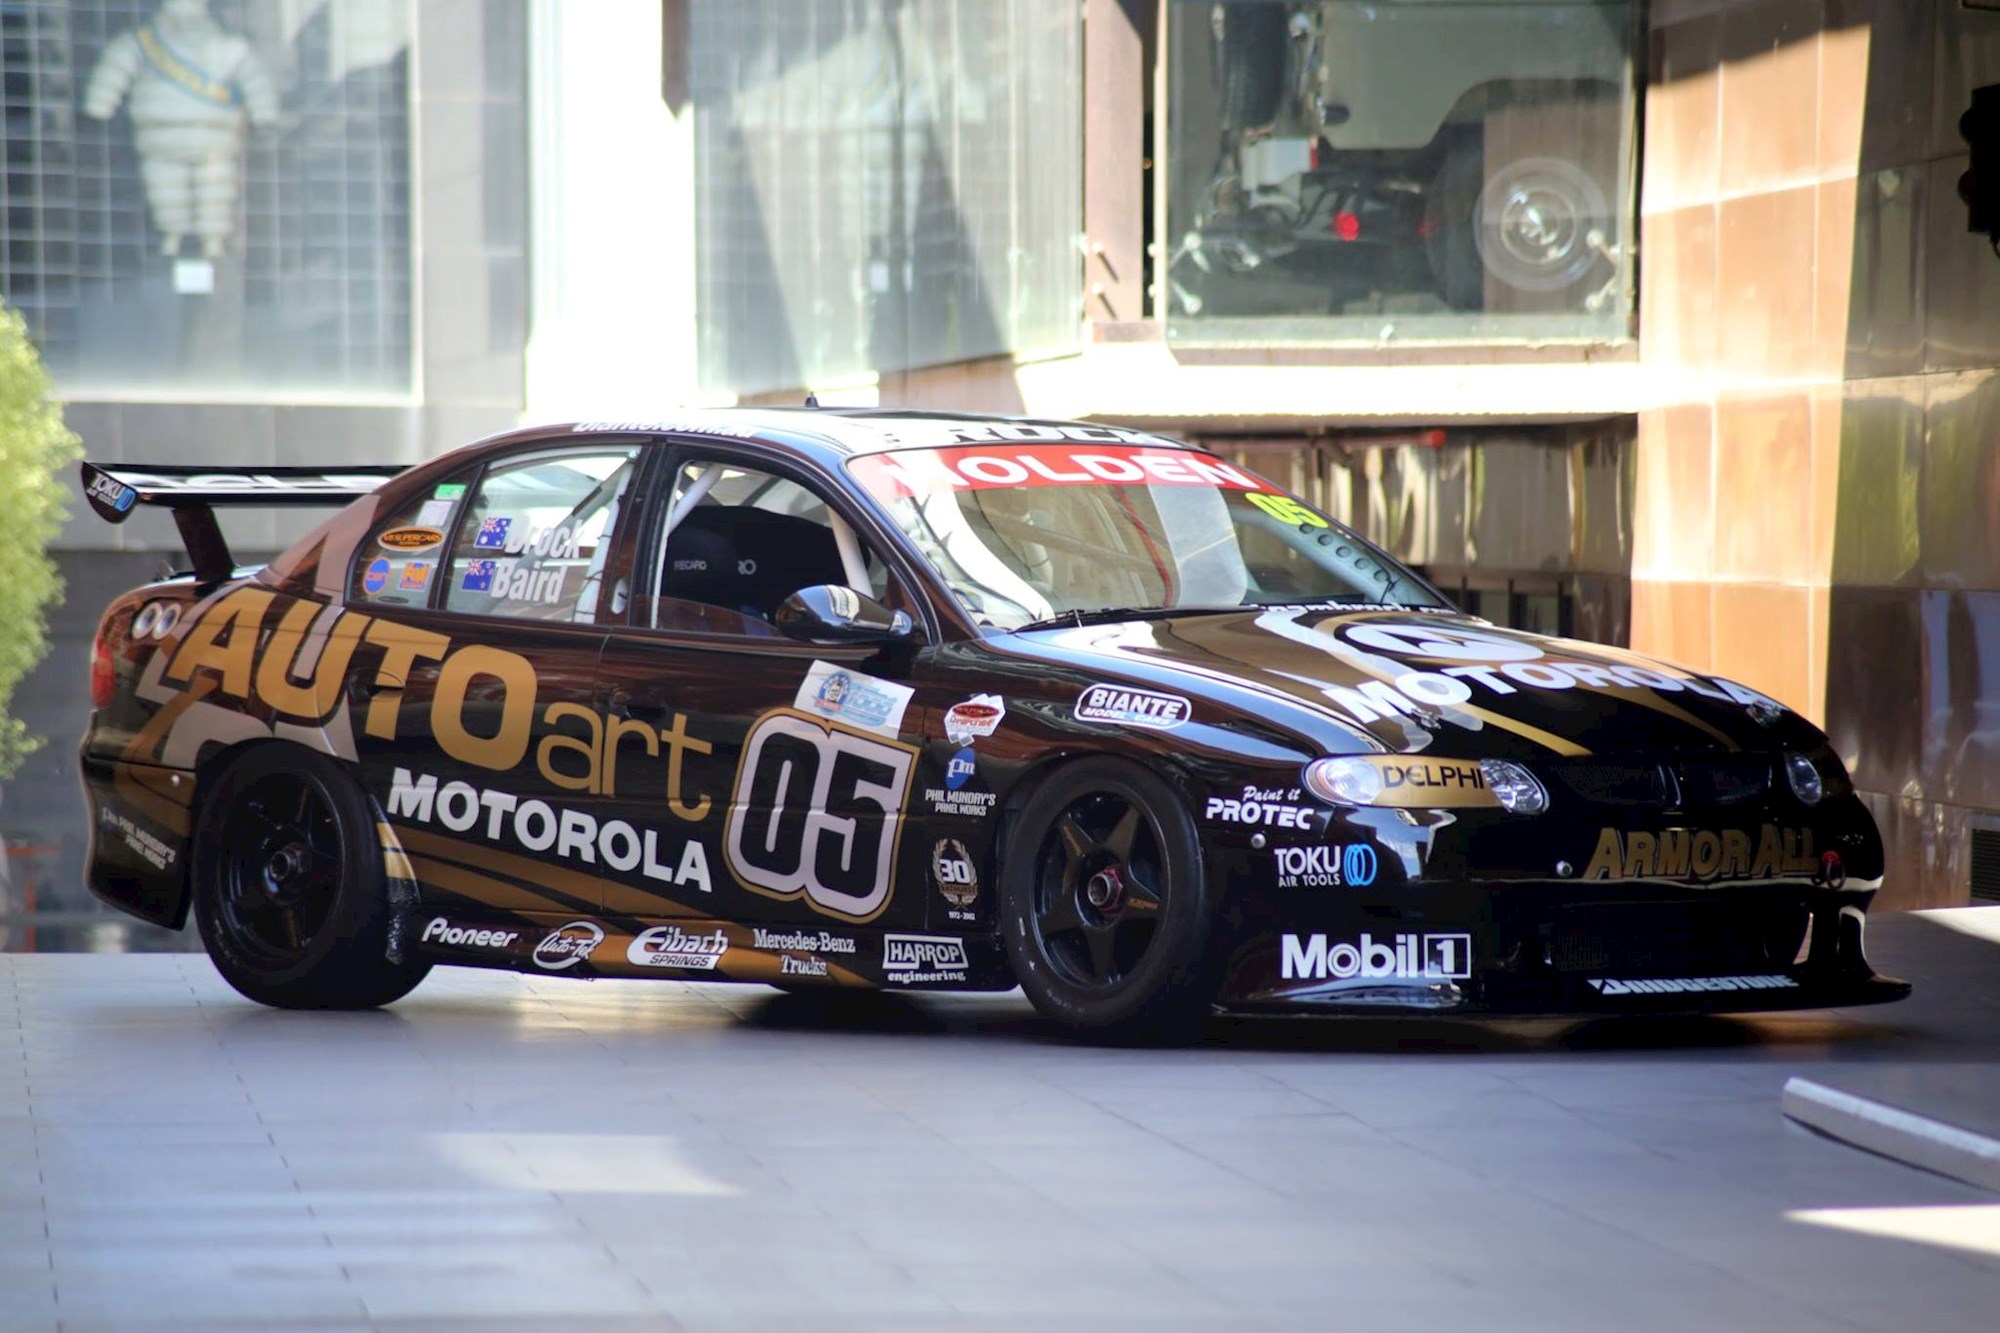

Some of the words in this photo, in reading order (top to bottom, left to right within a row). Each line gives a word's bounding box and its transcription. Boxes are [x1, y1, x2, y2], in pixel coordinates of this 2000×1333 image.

[872, 425, 1178, 448] ROCK
[878, 453, 1260, 491] HOLDEN
[91, 472, 125, 499] TOKU
[1246, 492, 1329, 528] 05
[505, 514, 584, 558] Brock
[674, 560, 707, 571] RECARO
[491, 558, 569, 603] Baird
[1089, 688, 1183, 720] BIANTE
[1321, 662, 1791, 725] MOTOROLA
[1083, 708, 1127, 719] MODEL
[1383, 766, 1484, 789] DELPHI
[925, 789, 945, 802] PHIL
[947, 790, 996, 806] MUNDAY'S
[1243, 786, 1283, 802] Paint
[1289, 788, 1300, 801] it
[725, 709, 916, 921] 05
[935, 802, 958, 814] PANEL
[960, 805, 987, 816] WORKS
[1206, 798, 1314, 830] PROTEC
[387, 767, 712, 892] MOTOROLA
[1274, 846, 1341, 875] TOKU
[1583, 826, 1751, 880] ARMOR
[1749, 823, 1820, 877] ALL
[939, 859, 971, 884] 30
[1278, 874, 1298, 888] AIR
[1302, 873, 1341, 887] TOOLS
[421, 916, 518, 947] Pioneer
[629, 926, 729, 959] Eibach
[753, 928, 856, 953] Mercedes-Benz
[649, 954, 711, 967] SPRINGS
[781, 953, 828, 977] Trucks
[890, 942, 962, 962] HARROP
[1281, 934, 1418, 979] Mobil
[888, 970, 966, 984] engineering
[1588, 975, 1799, 995] BRIDGESTONE
